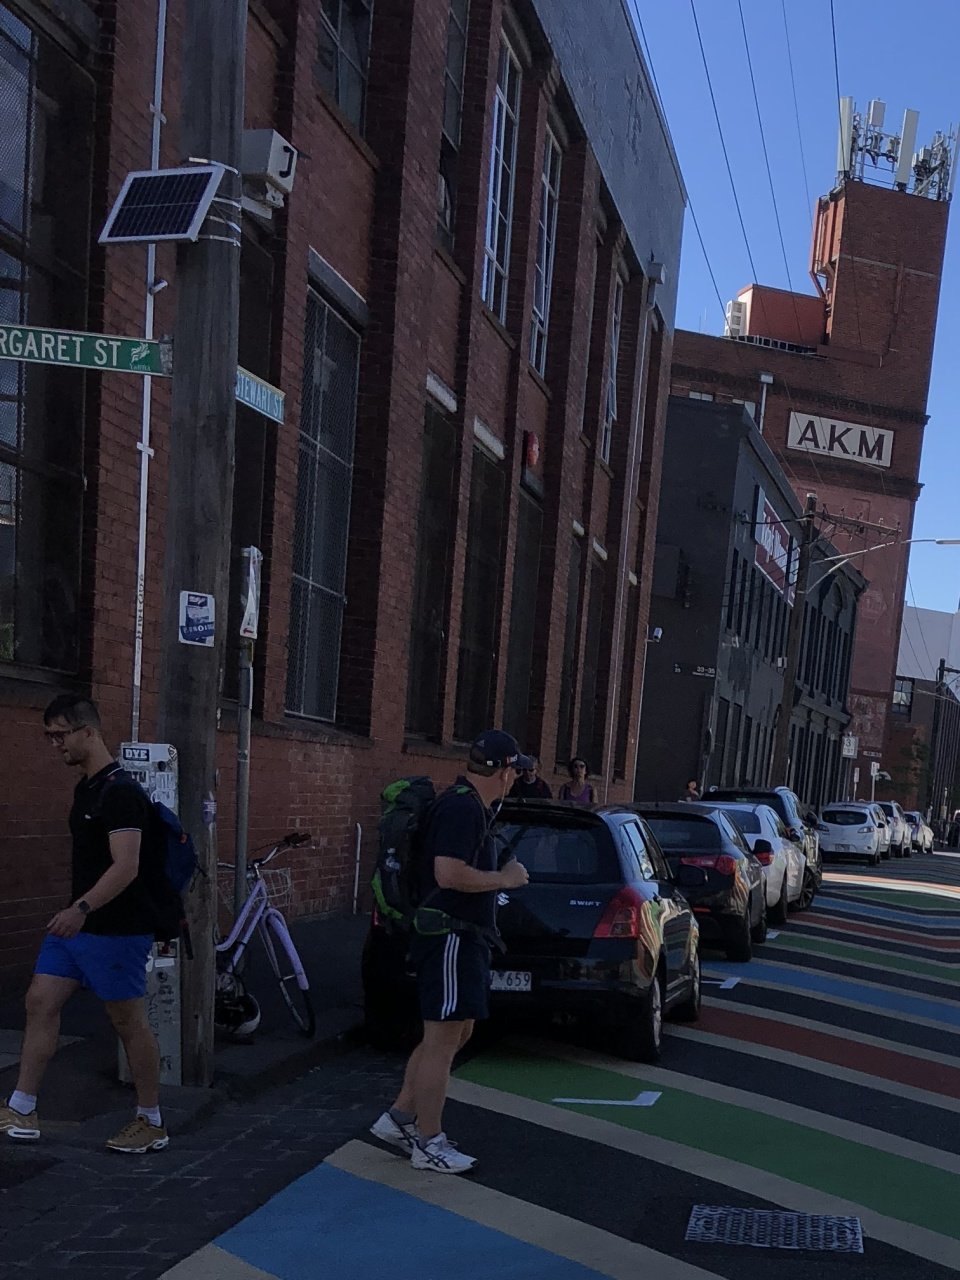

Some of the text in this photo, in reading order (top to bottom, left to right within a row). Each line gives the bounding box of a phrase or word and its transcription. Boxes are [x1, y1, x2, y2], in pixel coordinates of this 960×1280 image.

[94, 339, 121, 366] ST
[235, 371, 271, 413] STEWART
[797, 420, 885, 460] A.K.M
[126, 748, 147, 758] DYE
[506, 972, 530, 986] 659
